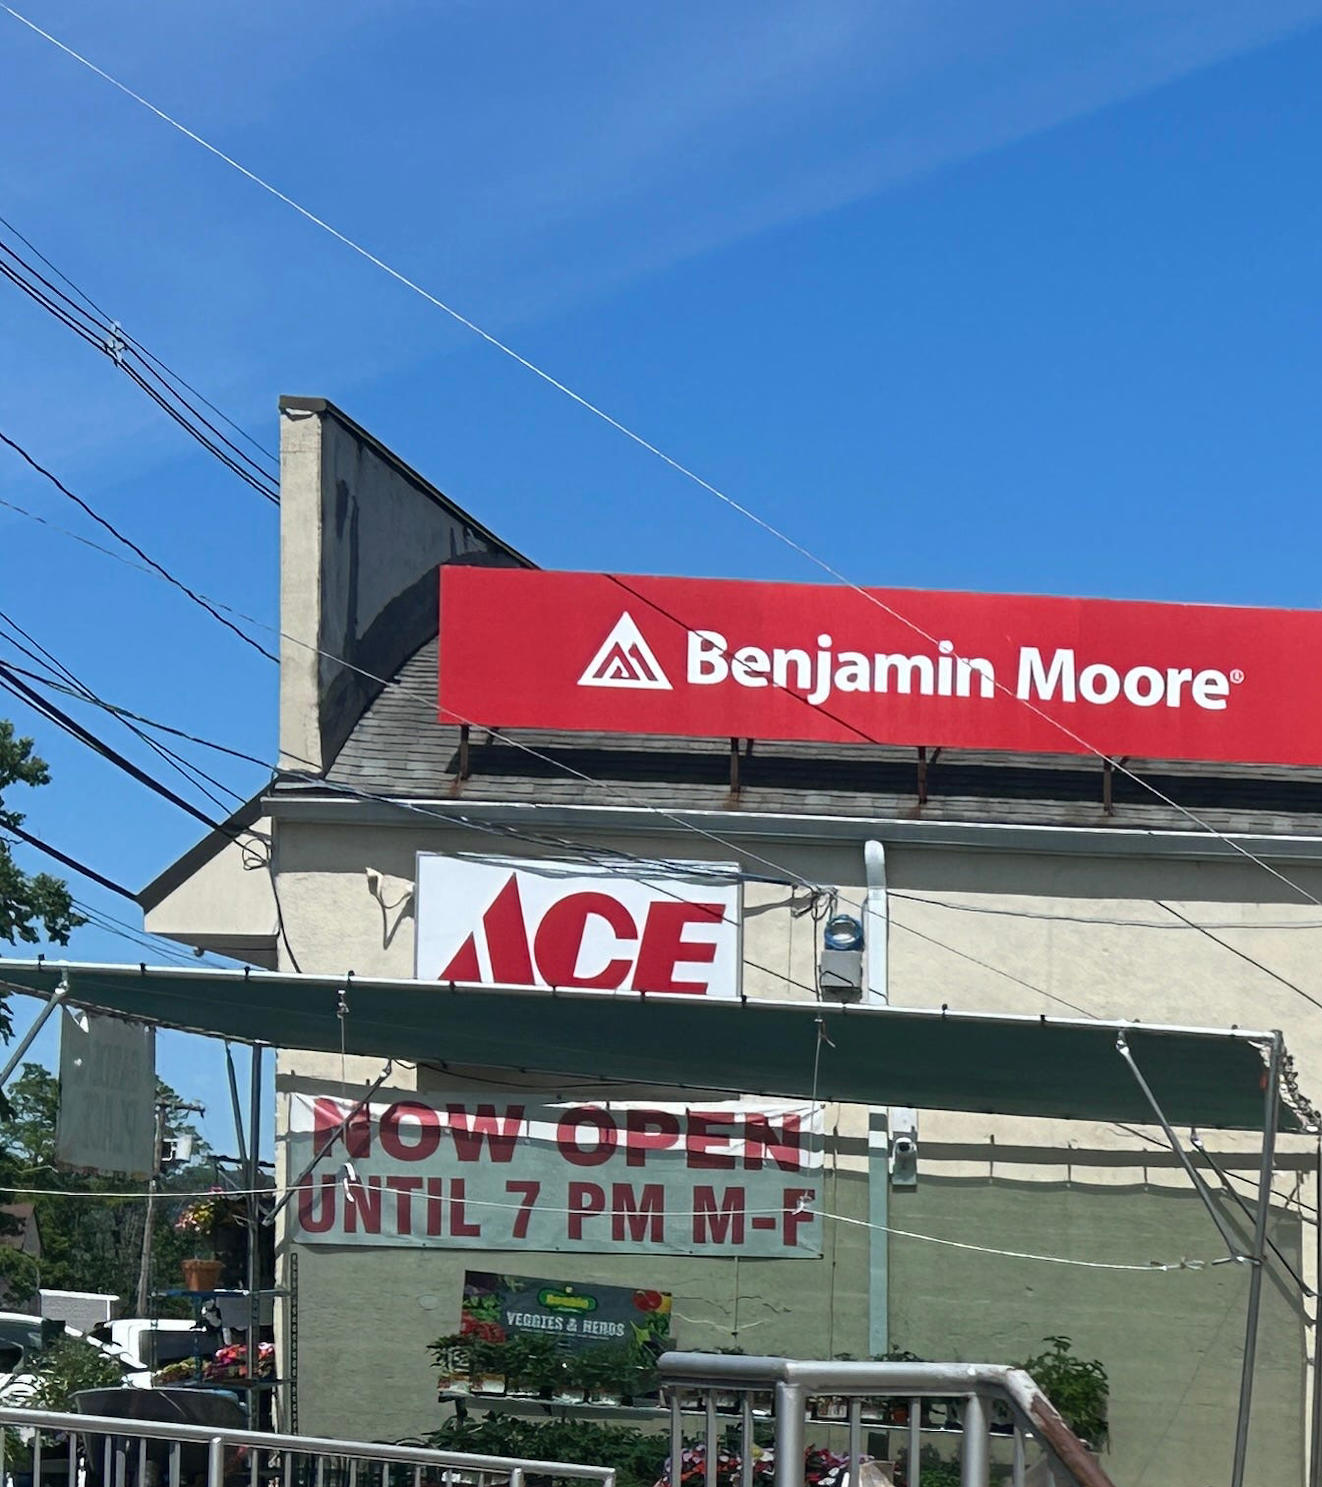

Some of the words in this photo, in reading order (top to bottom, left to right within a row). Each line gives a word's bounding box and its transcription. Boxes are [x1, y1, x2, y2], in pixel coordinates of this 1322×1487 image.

[687, 629, 995, 705] Benjamin
[1016, 646, 1230, 710] Moore
[437, 872, 726, 995] ACE
[313, 1097, 525, 1162] NOW
[557, 1104, 801, 1172] OPEN
[299, 1172, 481, 1237] UNTIL
[505, 1179, 541, 1239] 7
[568, 1181, 665, 1243] PM
[693, 1185, 816, 1246] M-F
[506, 1312, 564, 1331] VEGGIES
